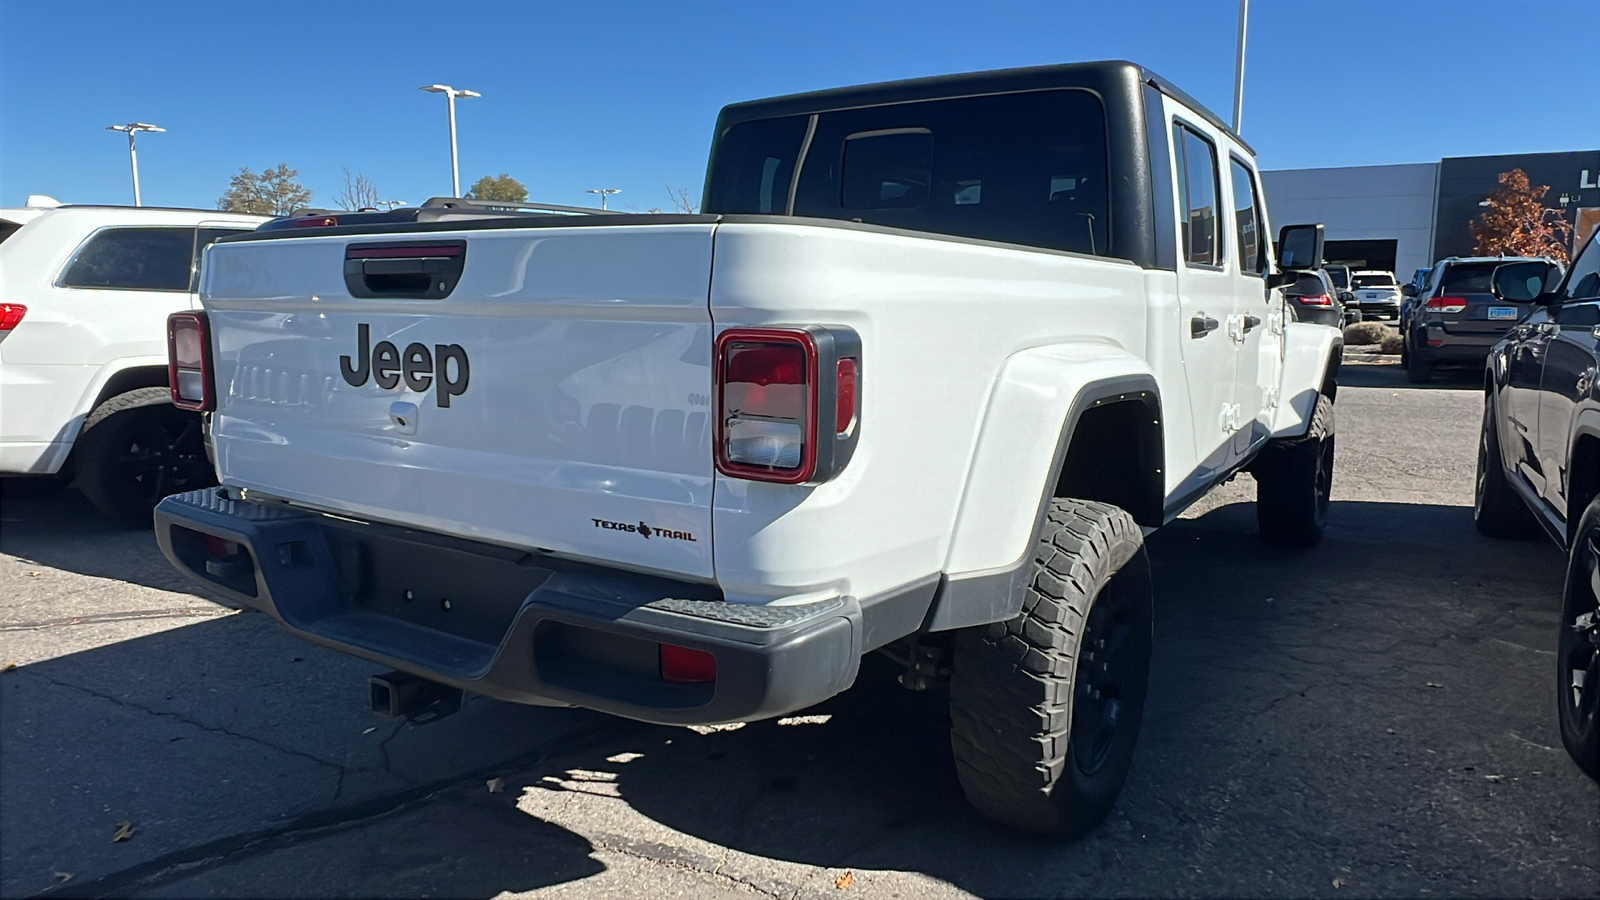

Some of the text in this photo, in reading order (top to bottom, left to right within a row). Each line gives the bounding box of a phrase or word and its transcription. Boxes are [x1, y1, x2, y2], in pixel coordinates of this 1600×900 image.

[339, 323, 470, 408] Jeep
[591, 518, 697, 542] TEXAS TRAIL
